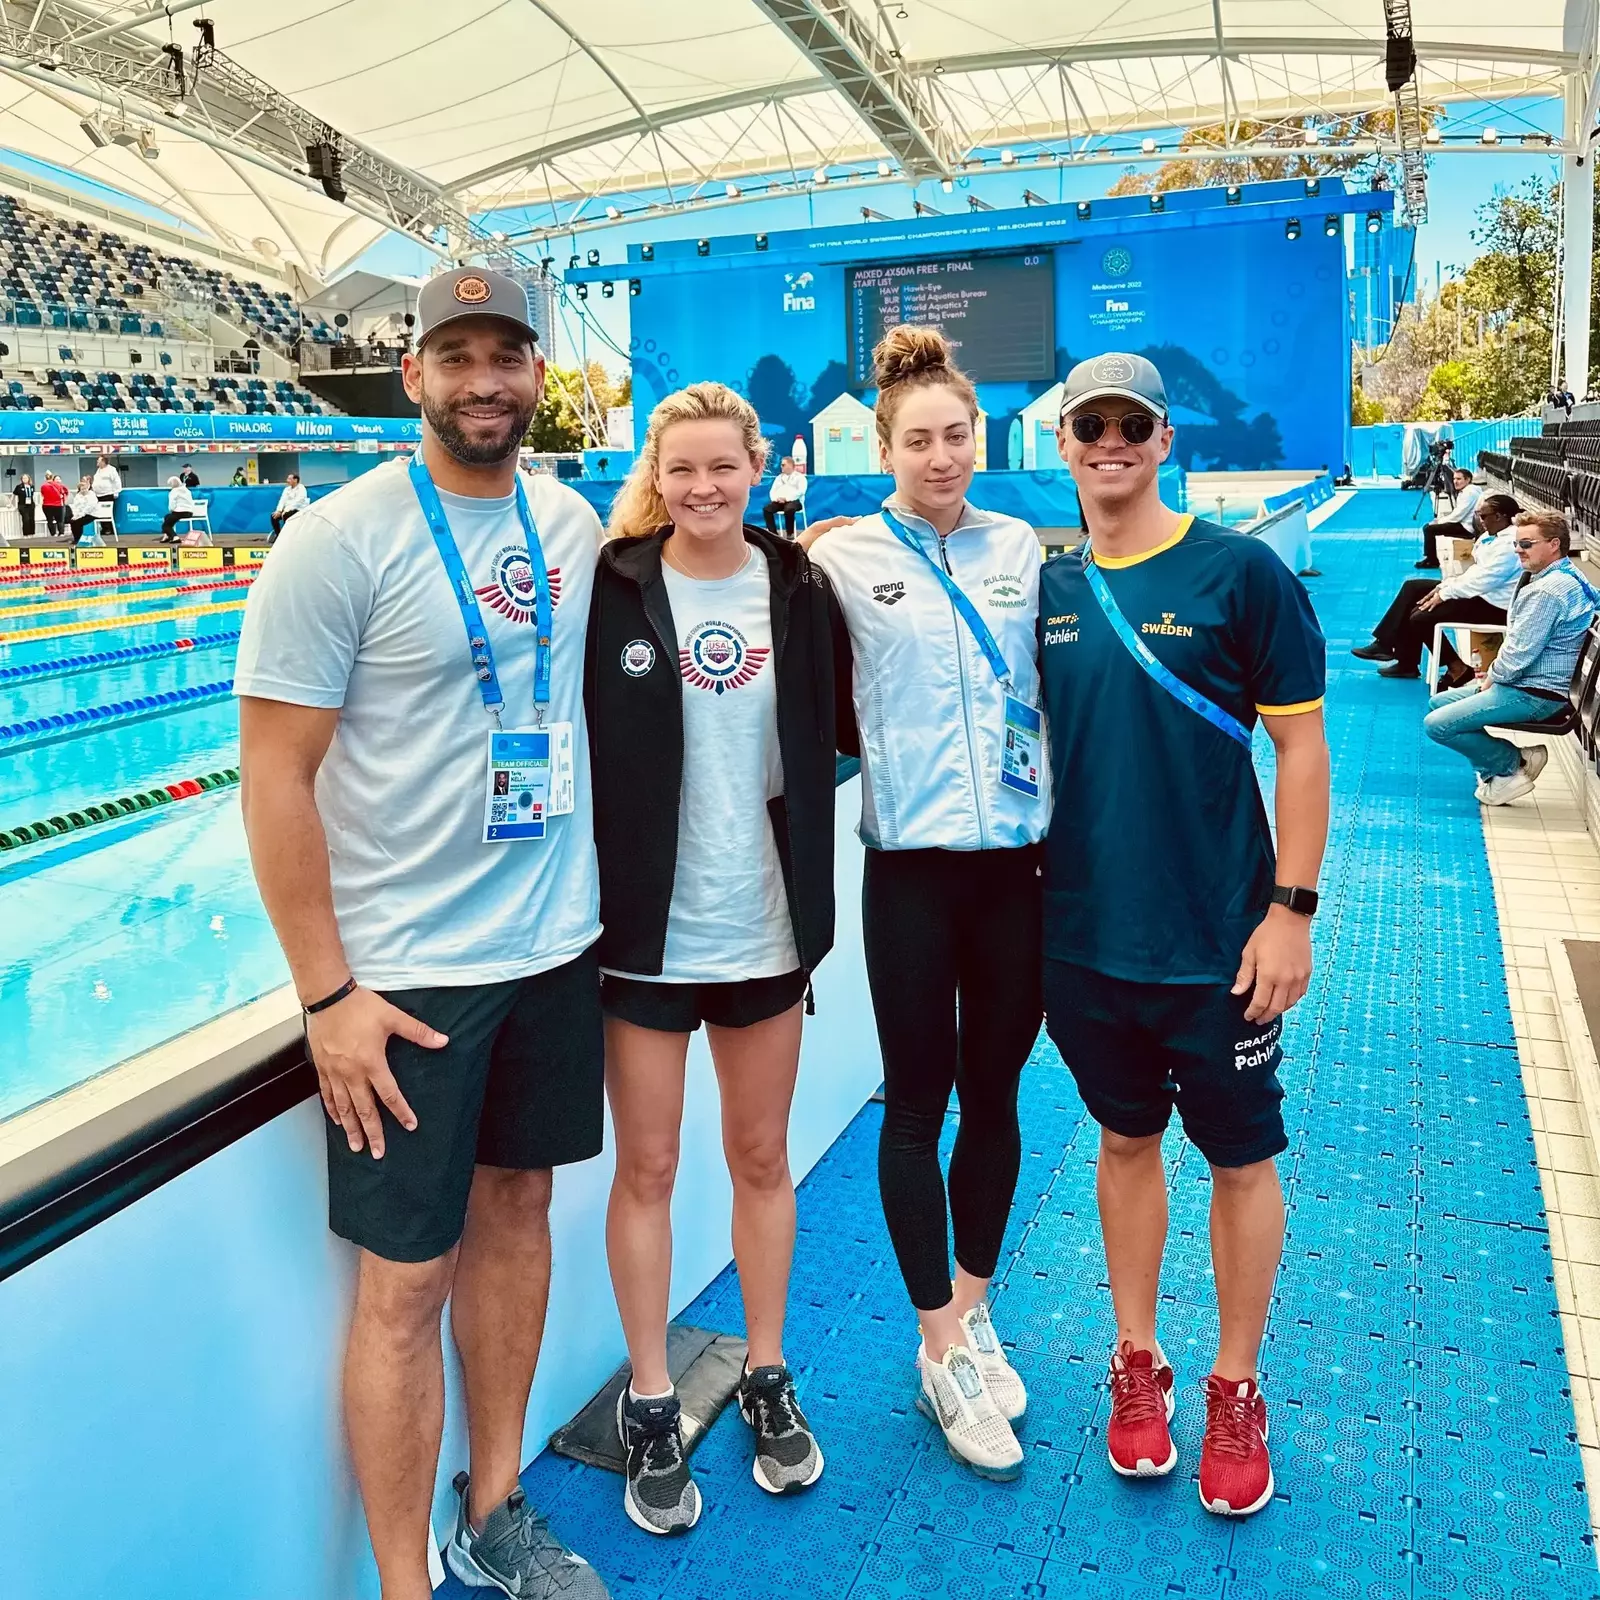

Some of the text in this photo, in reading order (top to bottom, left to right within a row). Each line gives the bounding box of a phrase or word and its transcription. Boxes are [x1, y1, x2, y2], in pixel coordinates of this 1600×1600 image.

[869, 234, 906, 243] SWIMMING
[907, 228, 968, 241] CHAMPIONSHIPS
[996, 221, 1043, 231] MELBOURNE
[1024, 255, 1039, 266] 0.0
[854, 269, 883, 280] MIXED
[884, 267, 915, 277] 4X50M
[916, 264, 939, 275] FREE
[946, 261, 974, 272] FINAL
[853, 278, 892, 288] START LIST
[1091, 282, 1126, 291] Melbourne
[857, 283, 942, 297] 0 HAW Hawk-Eye
[783, 292, 815, 312] Fina
[884, 296, 900, 304] BUR
[903, 294, 926, 302] World
[927, 291, 959, 302] Aquatics
[960, 290, 987, 298] Bureau
[879, 306, 900, 314] WAQ
[903, 304, 927, 312] World
[927, 301, 961, 311] Aquatics
[963, 300, 969, 308] 2
[1105, 299, 1129, 312] Fina
[858, 317, 863, 325] 3
[903, 314, 927, 322] Great
[928, 312, 940, 321] Big
[941, 311, 966, 319] Events
[1088, 312, 1112, 320] WORLD
[1092, 317, 1143, 326] CHAMPIONSHIPS
[859, 364, 865, 372] 8
[859, 373, 865, 381] 9
[60, 417, 85, 427] Myrtha
[60, 425, 80, 434] Pools
[173, 427, 204, 438] OMEGA
[229, 422, 273, 434] FINA.ORG
[295, 420, 333, 436] Nikon
[351, 423, 384, 434] Yakult
[513, 569, 528, 579] USA
[983, 574, 1024, 587] BULGARIA
[872, 581, 905, 594] arena
[988, 598, 1028, 609] SWIMMING
[1047, 614, 1071, 626] CRAFT
[1141, 622, 1193, 638] SWEDEN
[1044, 628, 1079, 646] Pahlén
[708, 641, 727, 650] USA
[515, 760, 543, 768] OFFICIAL
[491, 827, 497, 837] 2
[1234, 1029, 1273, 1051] CRAFT
